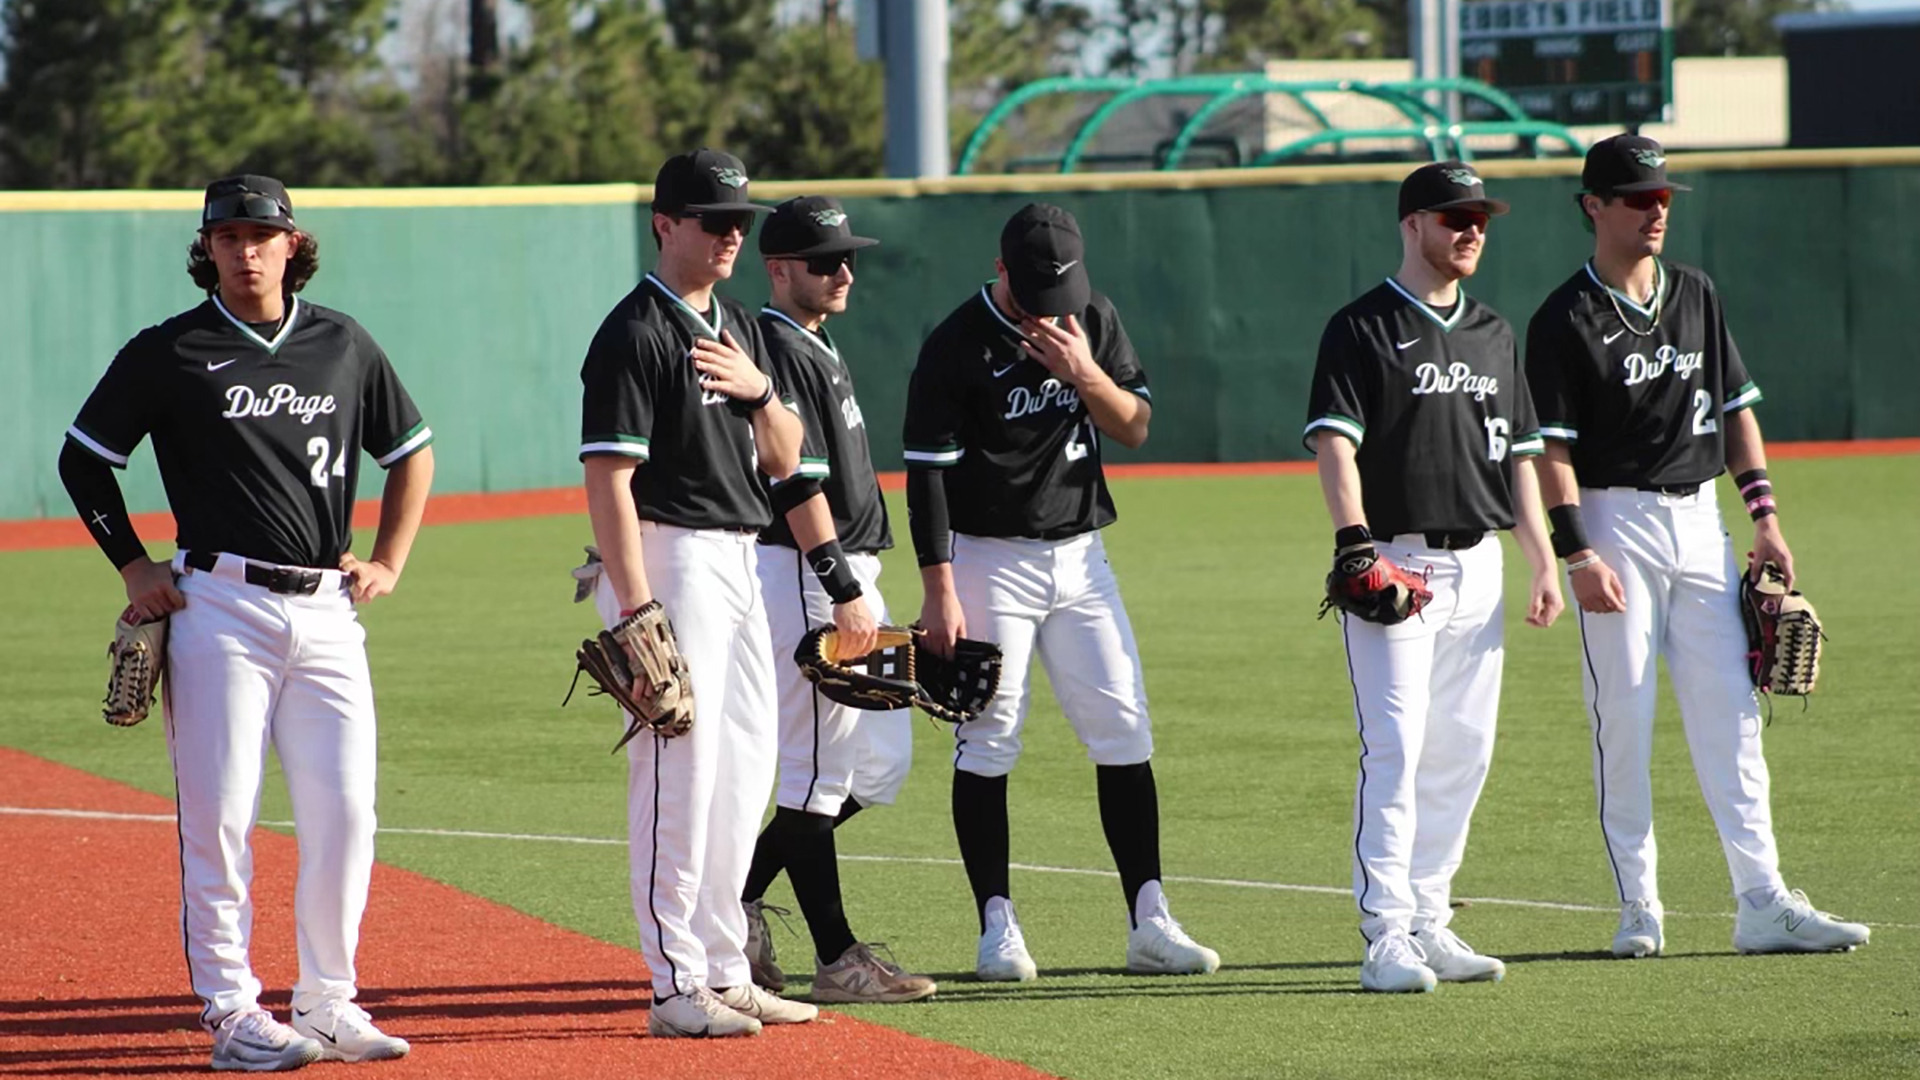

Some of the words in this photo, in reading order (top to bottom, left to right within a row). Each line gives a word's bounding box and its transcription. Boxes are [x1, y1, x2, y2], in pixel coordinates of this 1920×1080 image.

[1578, 0, 1660, 24] FIELD
[1004, 378, 1080, 420] DuPag
[1412, 361, 1499, 402] DuPage
[222, 383, 336, 425] DuPage
[1692, 388, 1718, 436] 2
[1484, 416, 1509, 462] 16
